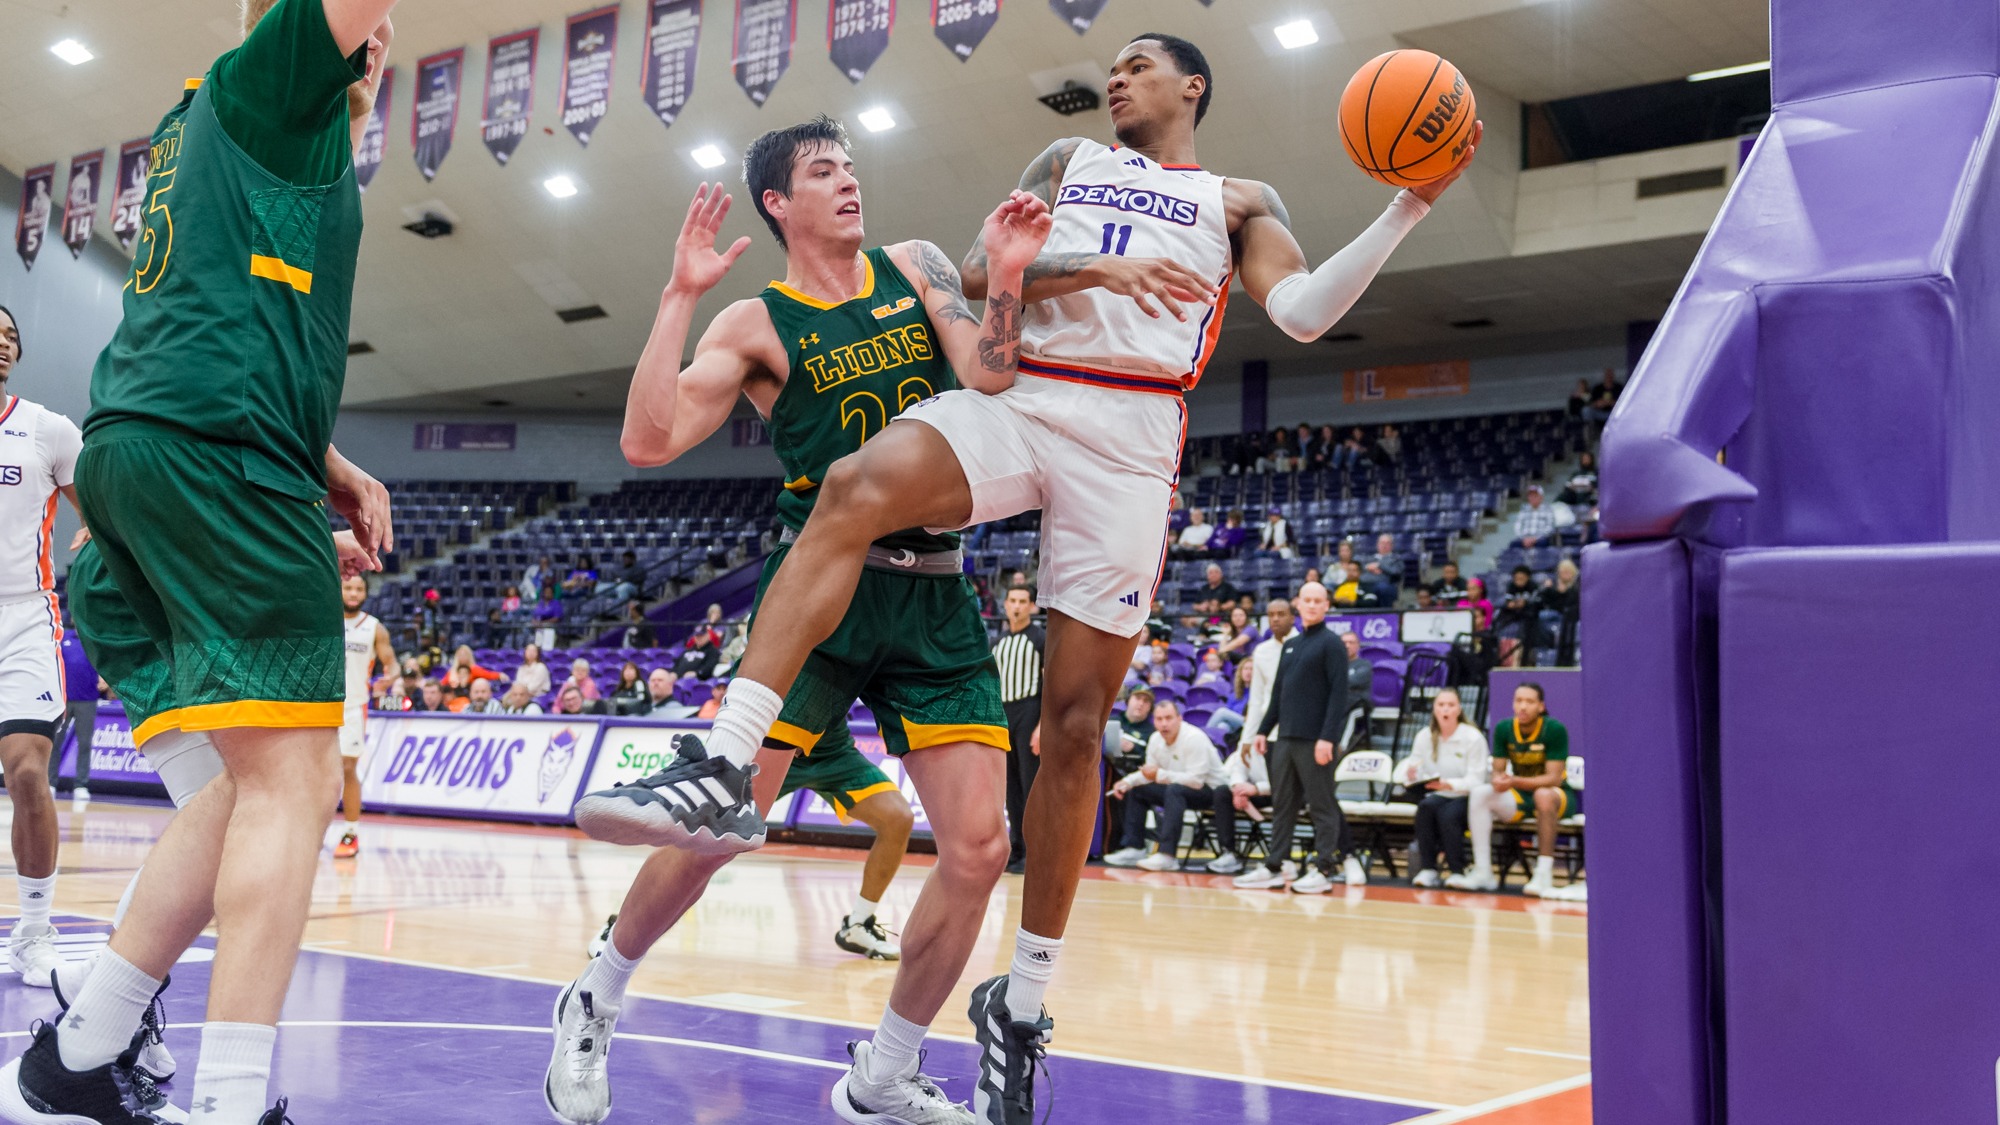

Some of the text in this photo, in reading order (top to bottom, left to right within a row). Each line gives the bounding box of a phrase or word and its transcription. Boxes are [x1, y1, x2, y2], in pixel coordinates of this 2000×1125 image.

[834, 12, 890, 41] 1974-75
[1413, 70, 1465, 143] Wilson
[113, 204, 142, 232] 24
[1060, 186, 1196, 225] DEMONS
[27, 228, 39, 252] 5
[69, 215, 91, 244] 14
[1100, 222, 1133, 256] 11
[804, 323, 934, 394] LIONS
[383, 734, 527, 790] DEMONS
[616, 743, 675, 777] Supe
